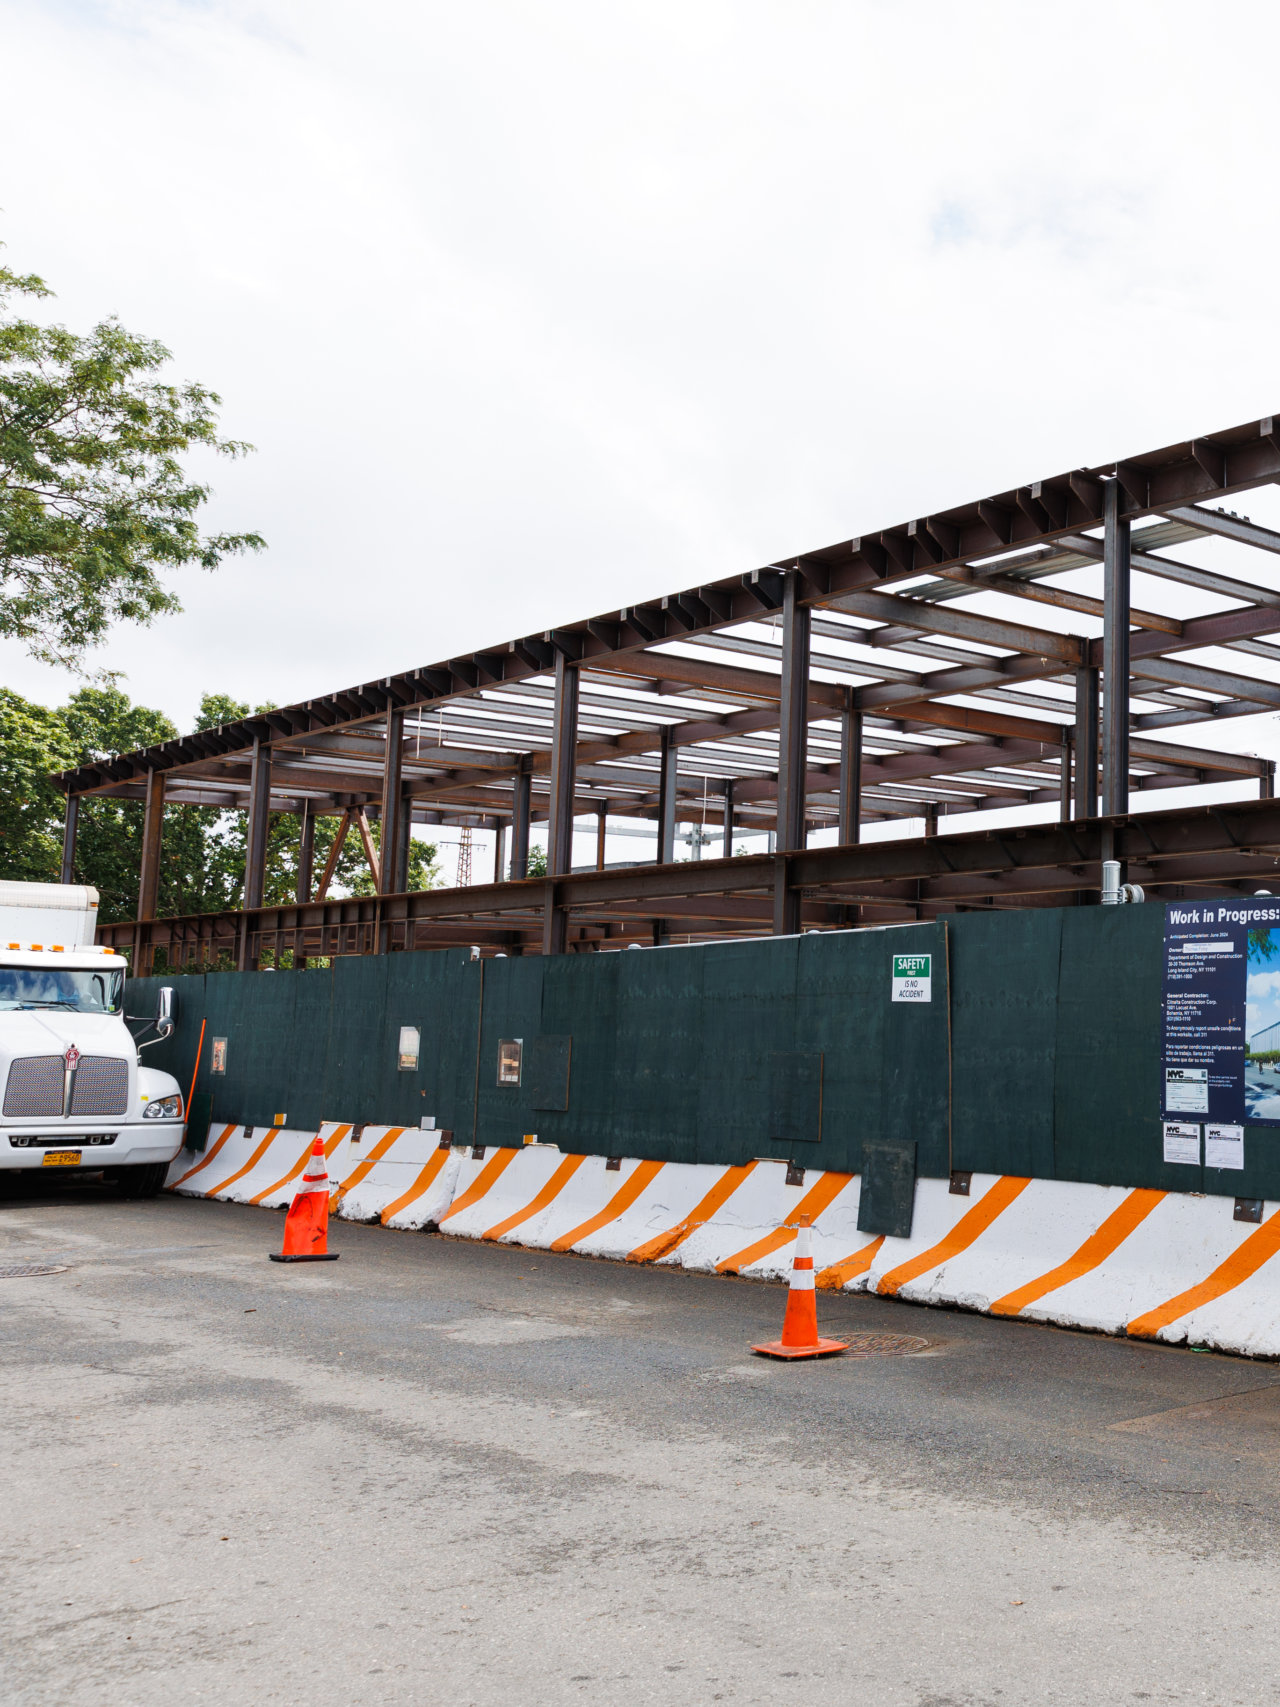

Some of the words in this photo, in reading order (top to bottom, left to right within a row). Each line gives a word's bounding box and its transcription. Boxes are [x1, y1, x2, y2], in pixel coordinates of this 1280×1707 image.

[1170, 909, 1199, 924] Work
[1203, 909, 1214, 922] in
[1218, 908, 1280, 924] Progress:
[898, 958, 925, 969] SAFETY
[899, 990, 923, 998] ACCIDENT
[1167, 1070, 1184, 1078] NYC
